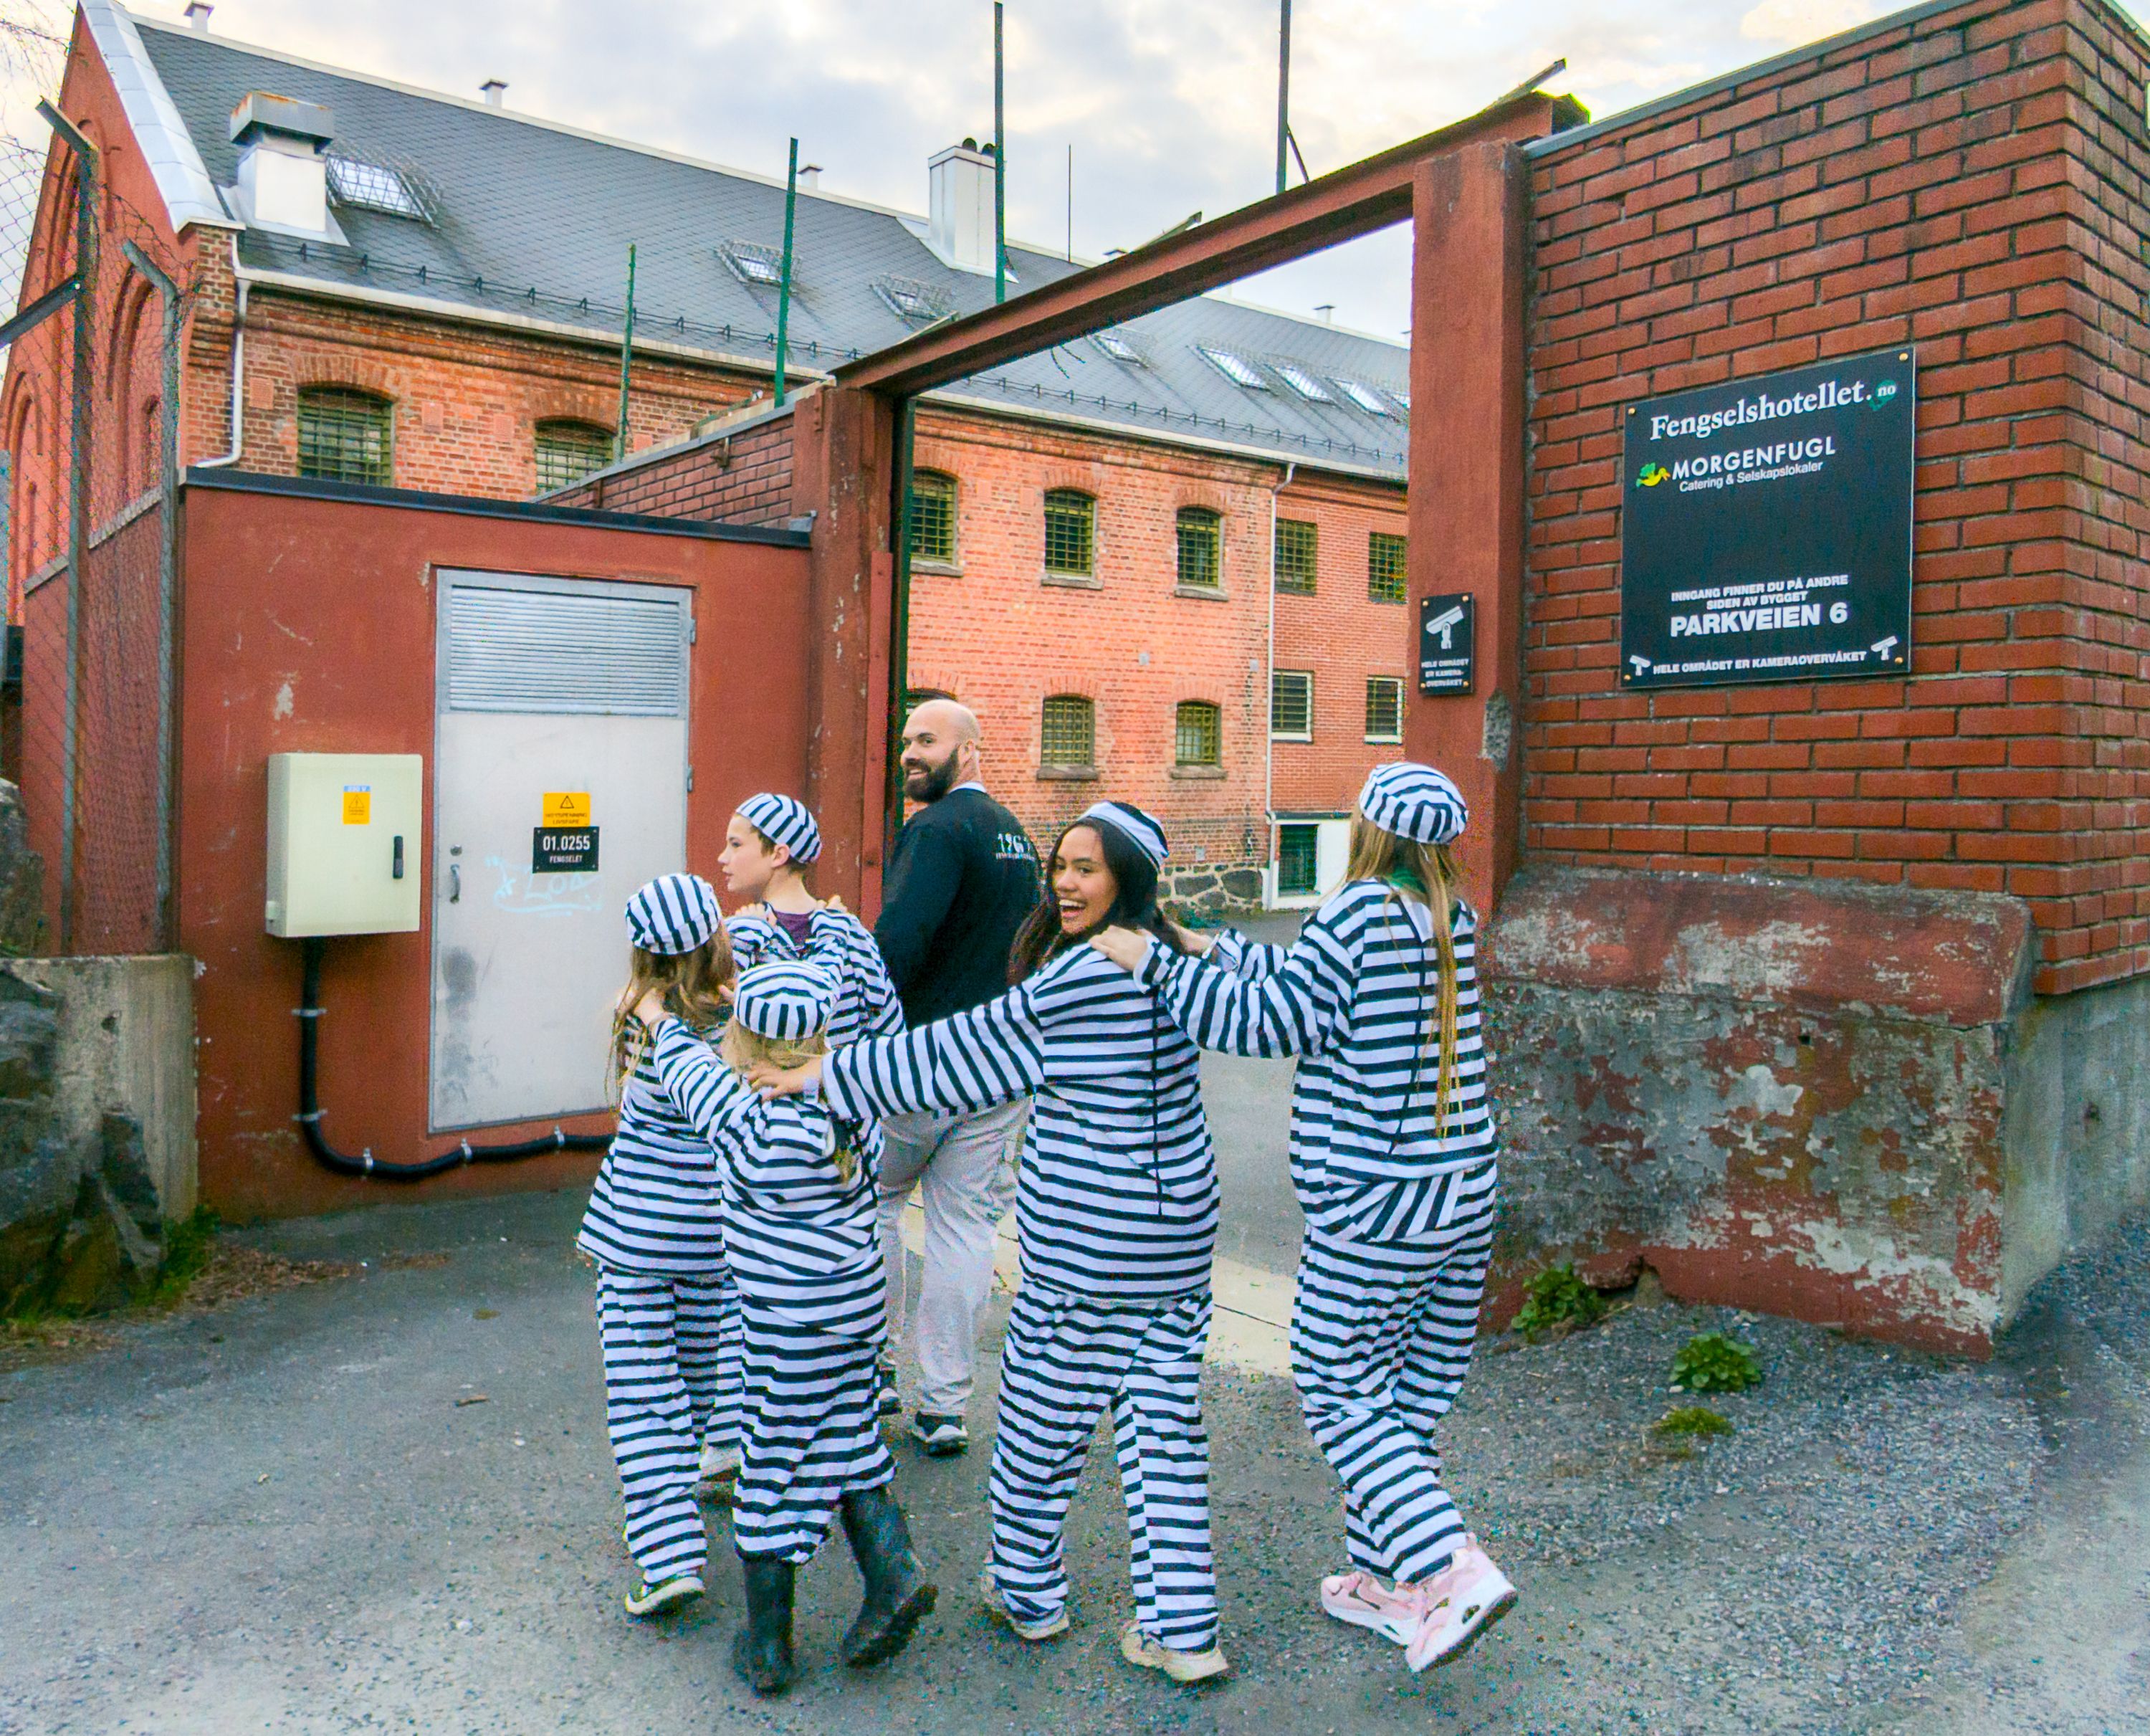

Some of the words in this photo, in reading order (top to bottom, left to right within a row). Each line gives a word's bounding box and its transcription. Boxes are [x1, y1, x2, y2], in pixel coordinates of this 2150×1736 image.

[1672, 436, 1836, 480] MORGENFUGL
[1679, 476, 1723, 492] Catering
[1726, 474, 1734, 485] &
[1737, 461, 1823, 483] Selskapslokaler
[1671, 588, 1720, 601] INNGANG
[1723, 583, 1764, 596] FINNER
[1767, 581, 1784, 592] DU
[1787, 577, 1803, 590] PÅ
[1806, 575, 1849, 588] ANDRE
[1706, 598, 1740, 610] SIDEN
[1743, 596, 1759, 606] AV
[1760, 591, 1808, 605] BYGGET
[1671, 604, 1820, 637] PARKVEIEN
[1829, 602, 1849, 624] 6
[1653, 664, 1679, 674] HELE
[1682, 659, 1732, 672] OMRÅDET
[1735, 659, 1749, 669] ER
[1752, 651, 1867, 668] KAMERAOVERVÅKET
[543, 835, 591, 851] 01.0255
